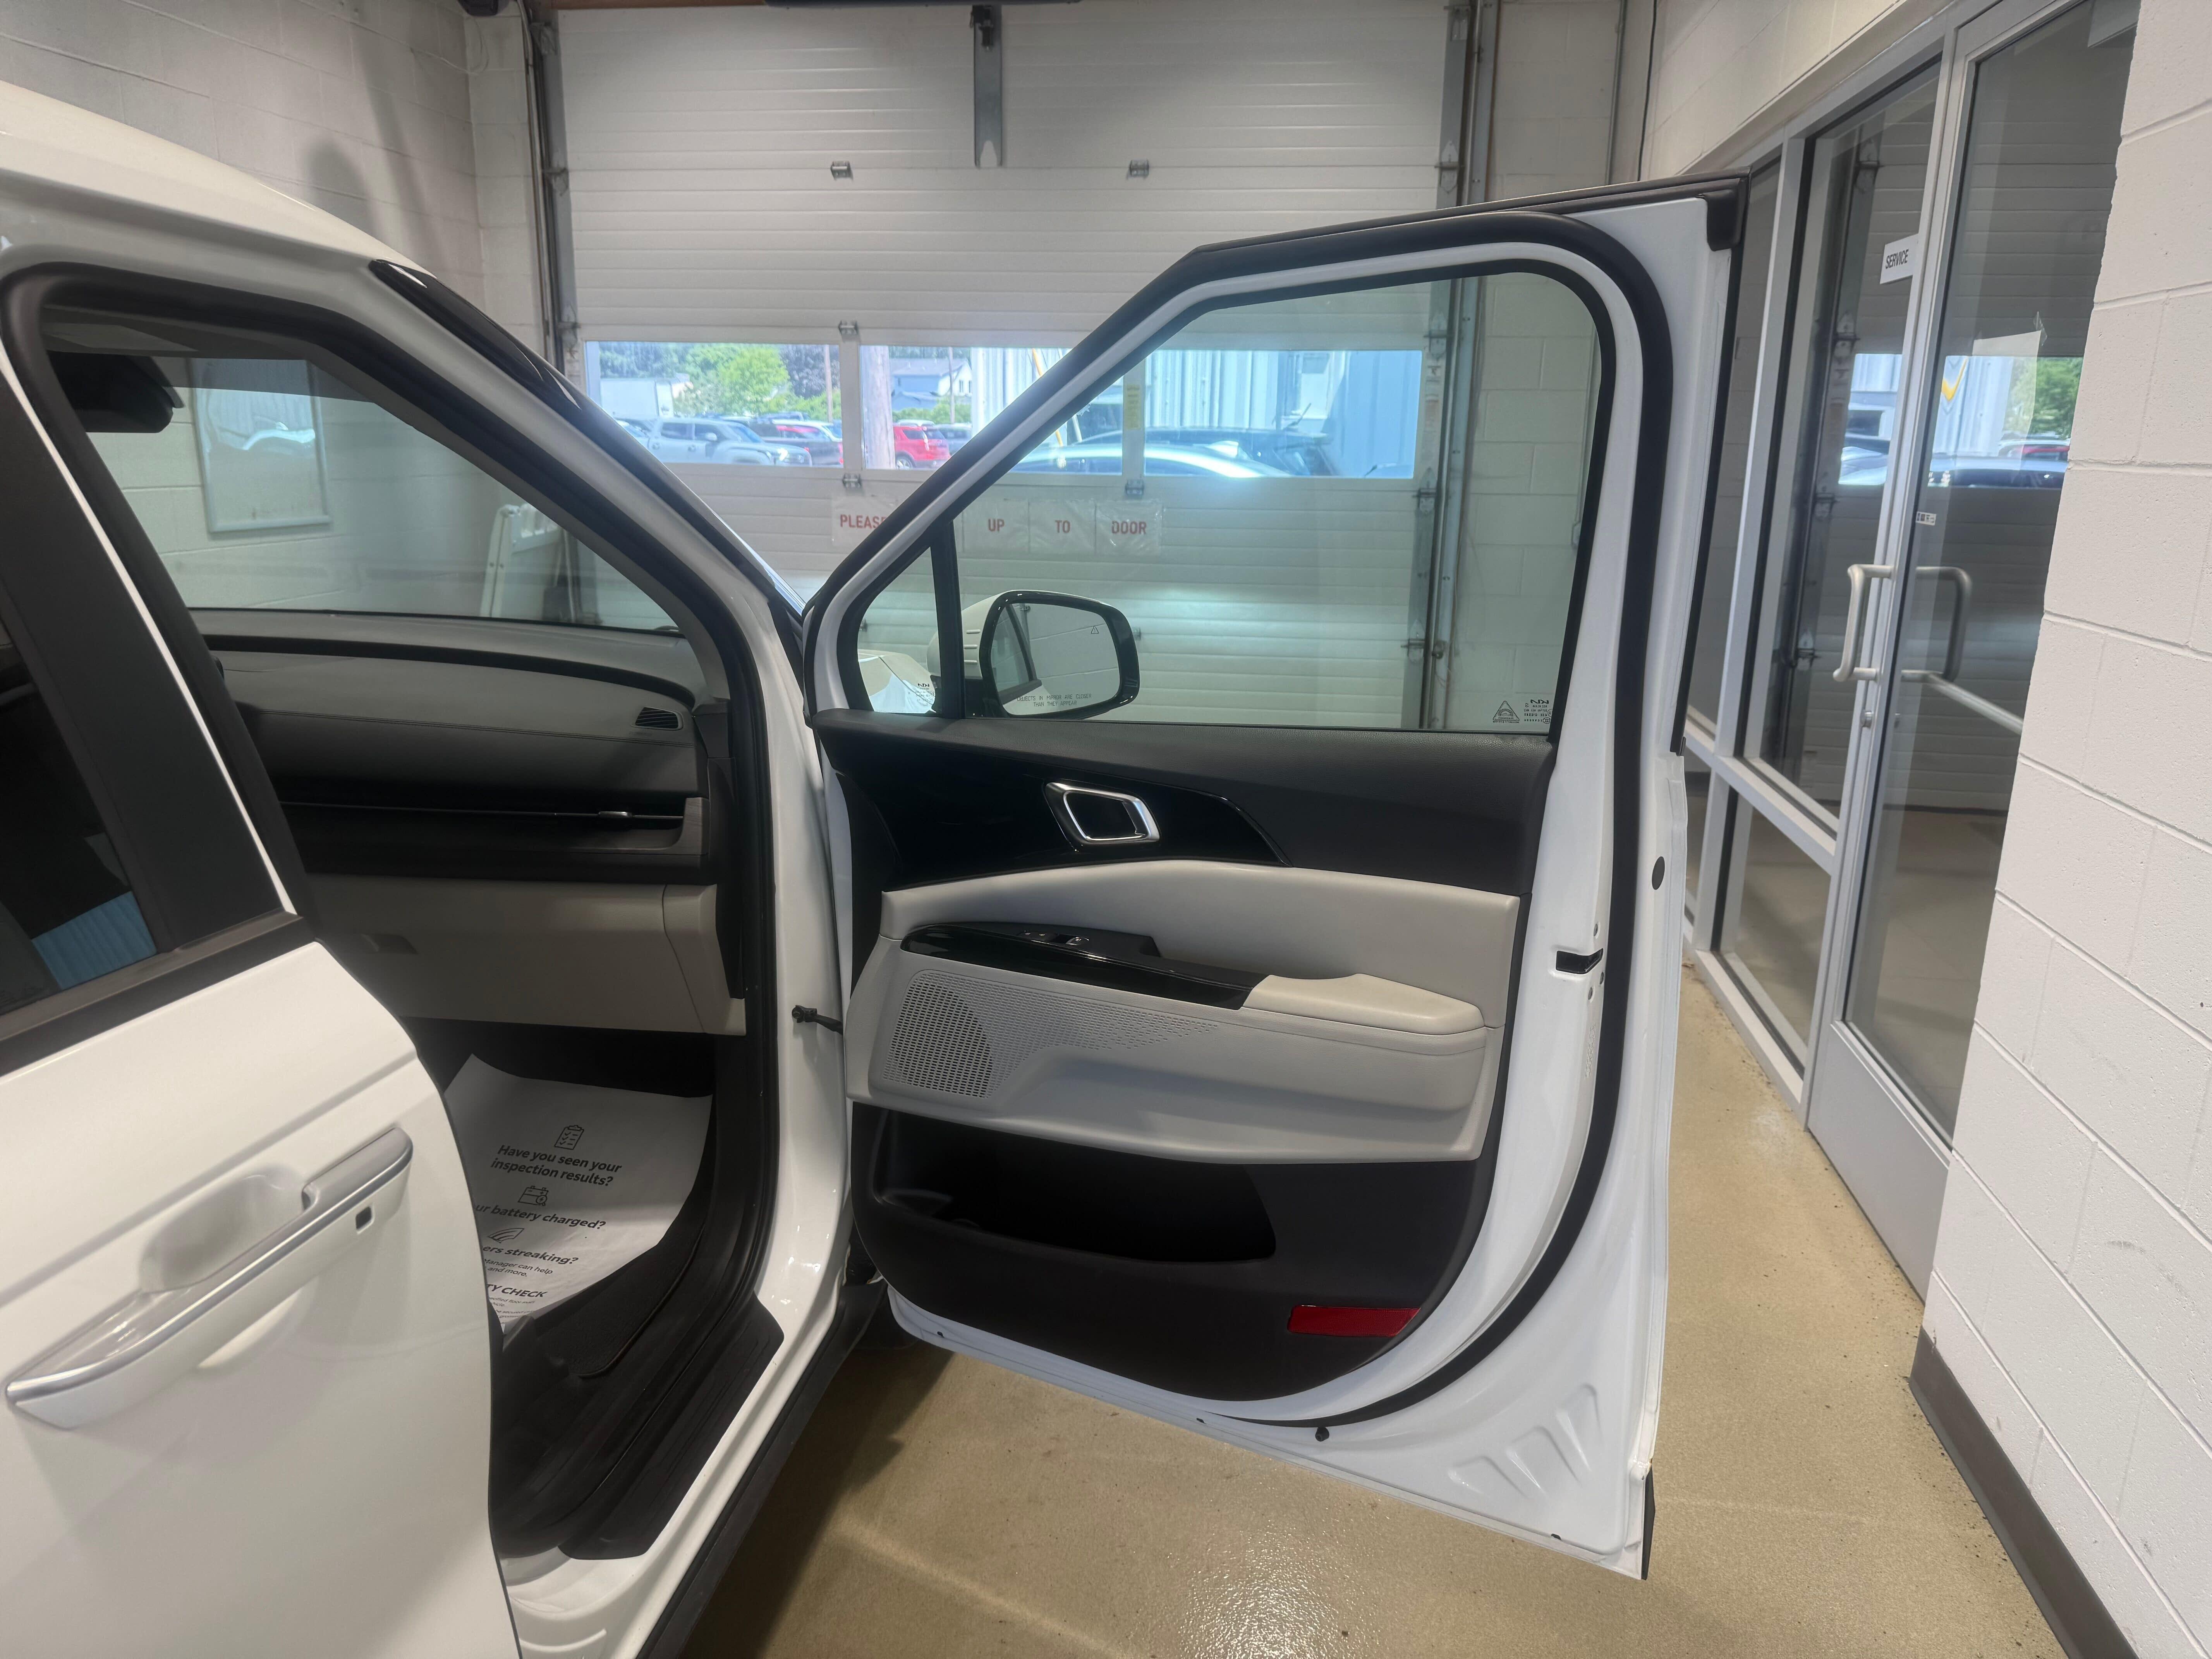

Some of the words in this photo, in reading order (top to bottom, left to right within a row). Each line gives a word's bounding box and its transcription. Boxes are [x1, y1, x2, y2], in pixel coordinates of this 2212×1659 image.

[1885, 249, 1909, 269] SERVICE
[988, 518, 1005, 532] UP
[1054, 520, 1071, 534] TO
[1111, 520, 1147, 534] DOOR
[497, 1144, 530, 1158] Have
[530, 1151, 556, 1162] you
[558, 1156, 589, 1168] seen
[589, 1161, 622, 1173] your
[490, 1158, 558, 1178] inspection
[560, 1171, 613, 1186] results?
[490, 1205, 541, 1221] battery
[543, 1214, 606, 1230] charged?
[505, 1248, 579, 1265] streaking?
[504, 1269, 527, 1277] more.
[534, 1266, 553, 1275] help
[487, 1284, 503, 1292] TY
[502, 1287, 547, 1297] CHECK
